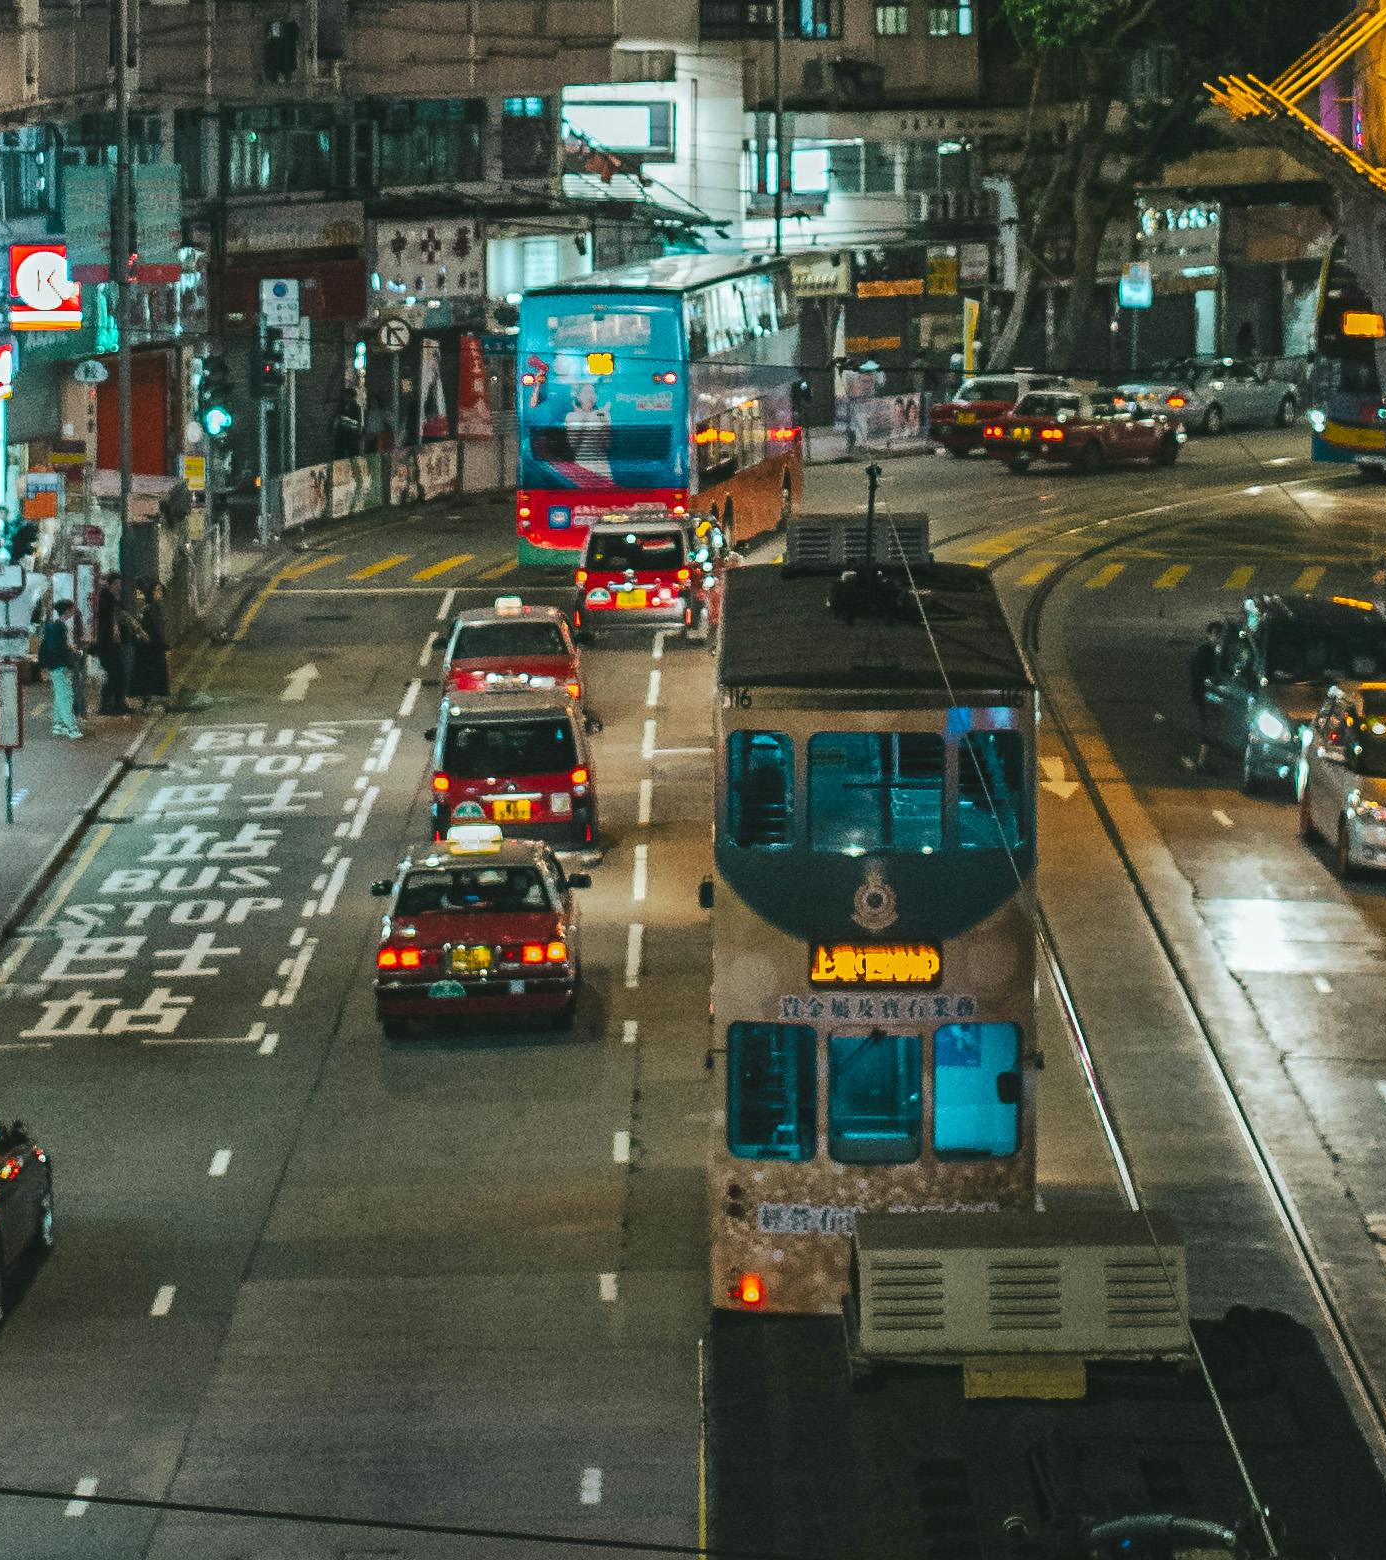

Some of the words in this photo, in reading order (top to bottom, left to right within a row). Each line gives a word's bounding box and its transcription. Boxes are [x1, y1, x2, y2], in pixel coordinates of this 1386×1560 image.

[191, 727, 346, 753] BUS
[159, 753, 346, 778] STOP
[142, 780, 324, 822] 巴士
[138, 823, 283, 862] 站
[99, 865, 282, 894] BUS
[60, 896, 284, 934] STOP
[40, 932, 241, 981] 巴士
[19, 988, 194, 1038] 站
